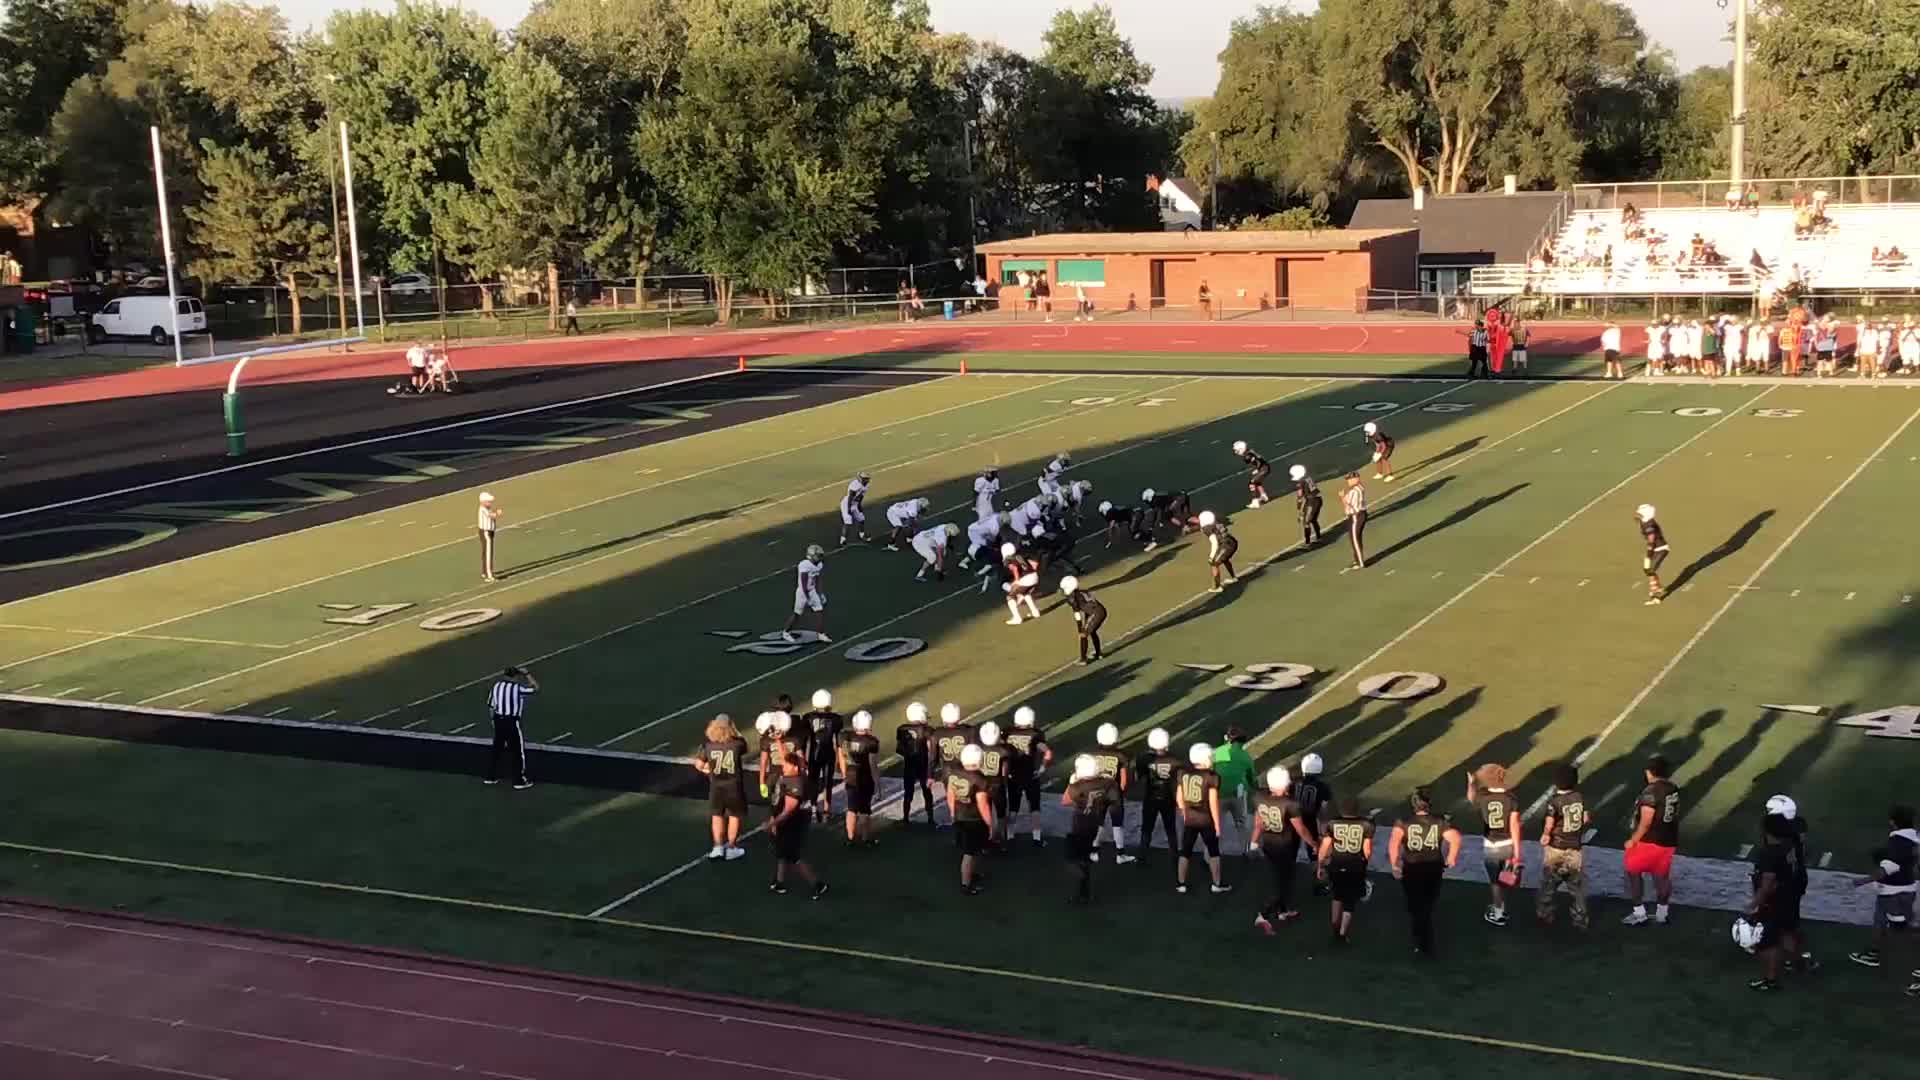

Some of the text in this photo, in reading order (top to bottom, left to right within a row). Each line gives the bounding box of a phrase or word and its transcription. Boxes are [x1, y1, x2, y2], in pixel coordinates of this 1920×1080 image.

[710, 750, 735, 775] 74
[1182, 773, 1204, 803] 16
[1488, 802, 1505, 829] 2
[1563, 803, 1584, 832] 13
[1333, 823, 1365, 854] 59
[1407, 824, 1439, 852] 64
